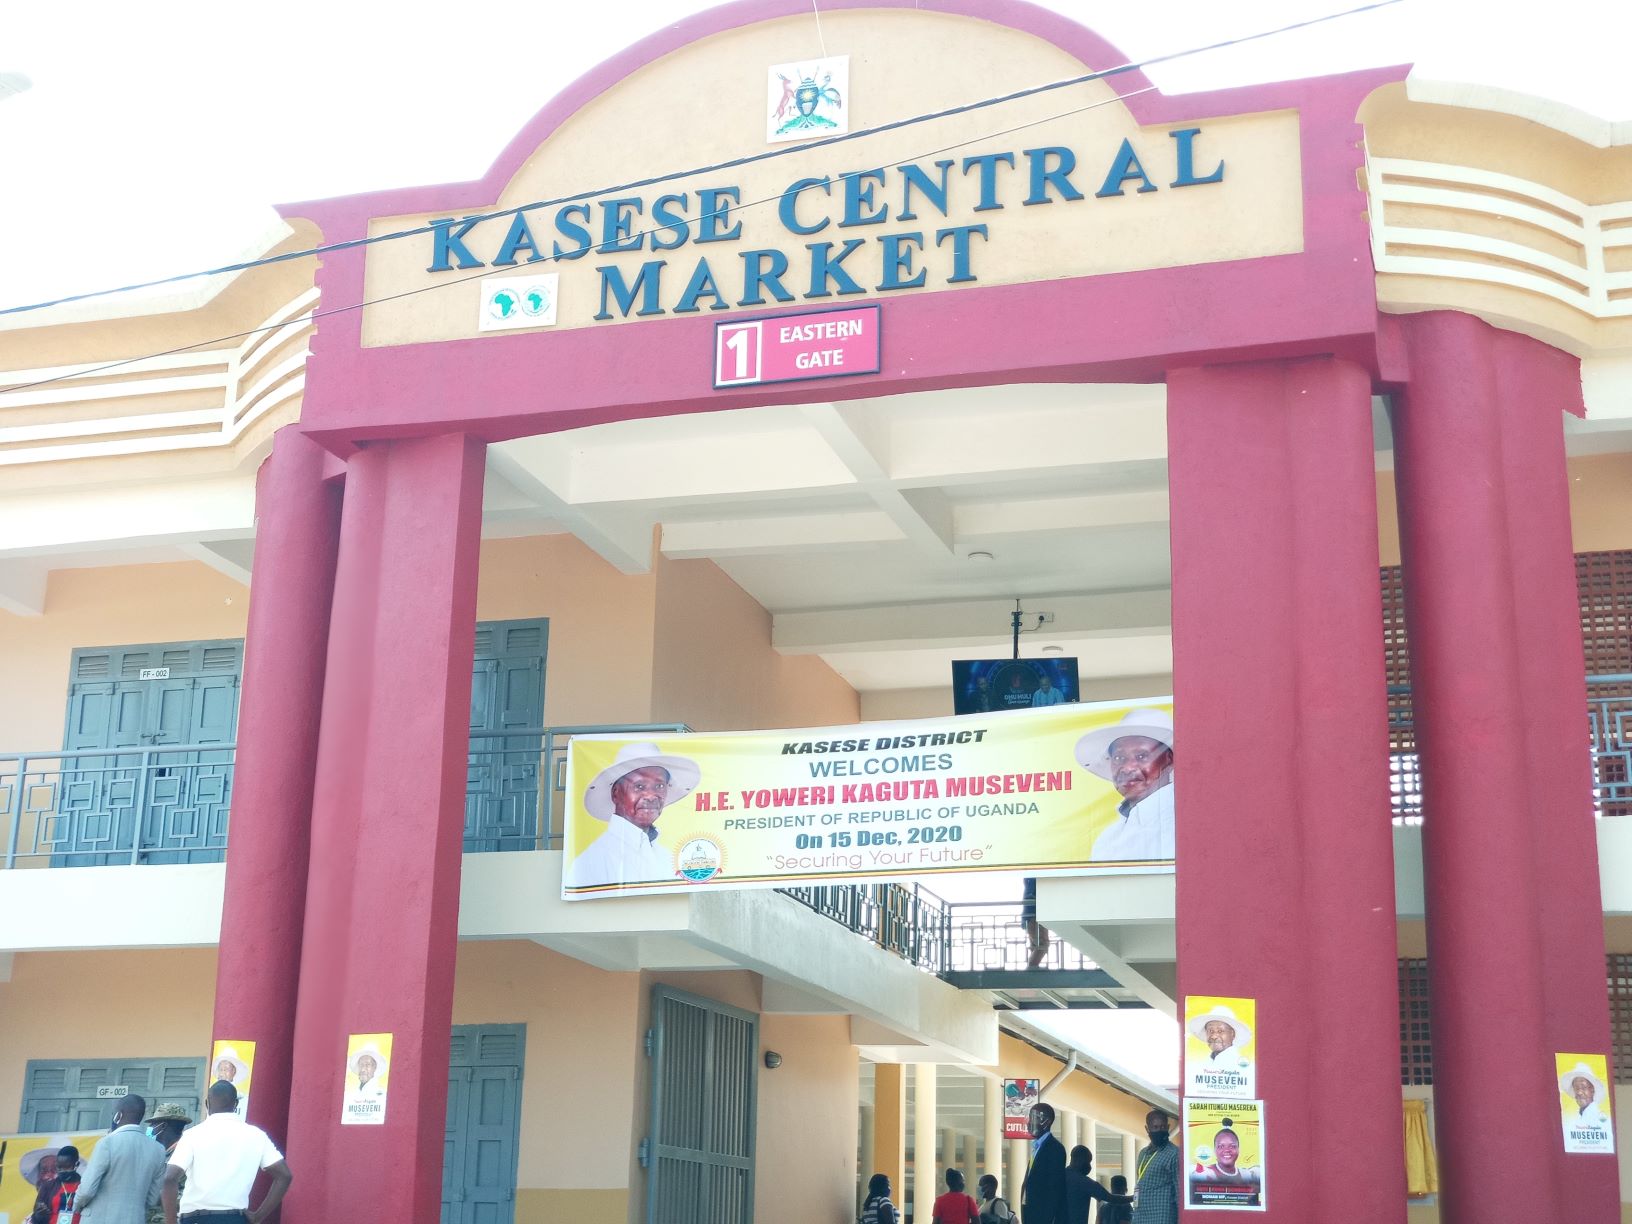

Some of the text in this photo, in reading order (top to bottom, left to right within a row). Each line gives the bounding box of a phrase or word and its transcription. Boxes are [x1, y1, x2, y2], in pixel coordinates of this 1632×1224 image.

[426, 128, 1225, 273] KASESE CENTRAL
[593, 224, 988, 321] MARKET
[780, 319, 863, 344] EASTERN
[726, 330, 747, 378] 1
[795, 349, 844, 369] GATE
[781, 729, 987, 755] KASESE DISTRICT
[809, 753, 953, 778] WELCOMES
[695, 770, 1072, 811] H.E. YOWERI KAGUTA MUSEVENI
[724, 802, 1040, 830] PRESIDENT OF REPUBLIC OF UGANDA
[795, 825, 962, 849] On 15 Dec, 2020
[868, 850, 913, 866] Your
[1195, 1074, 1248, 1086] MUSEVENI
[1189, 1102, 1207, 1110] SARAH
[1570, 1131, 1608, 1140] MUSEVENI
